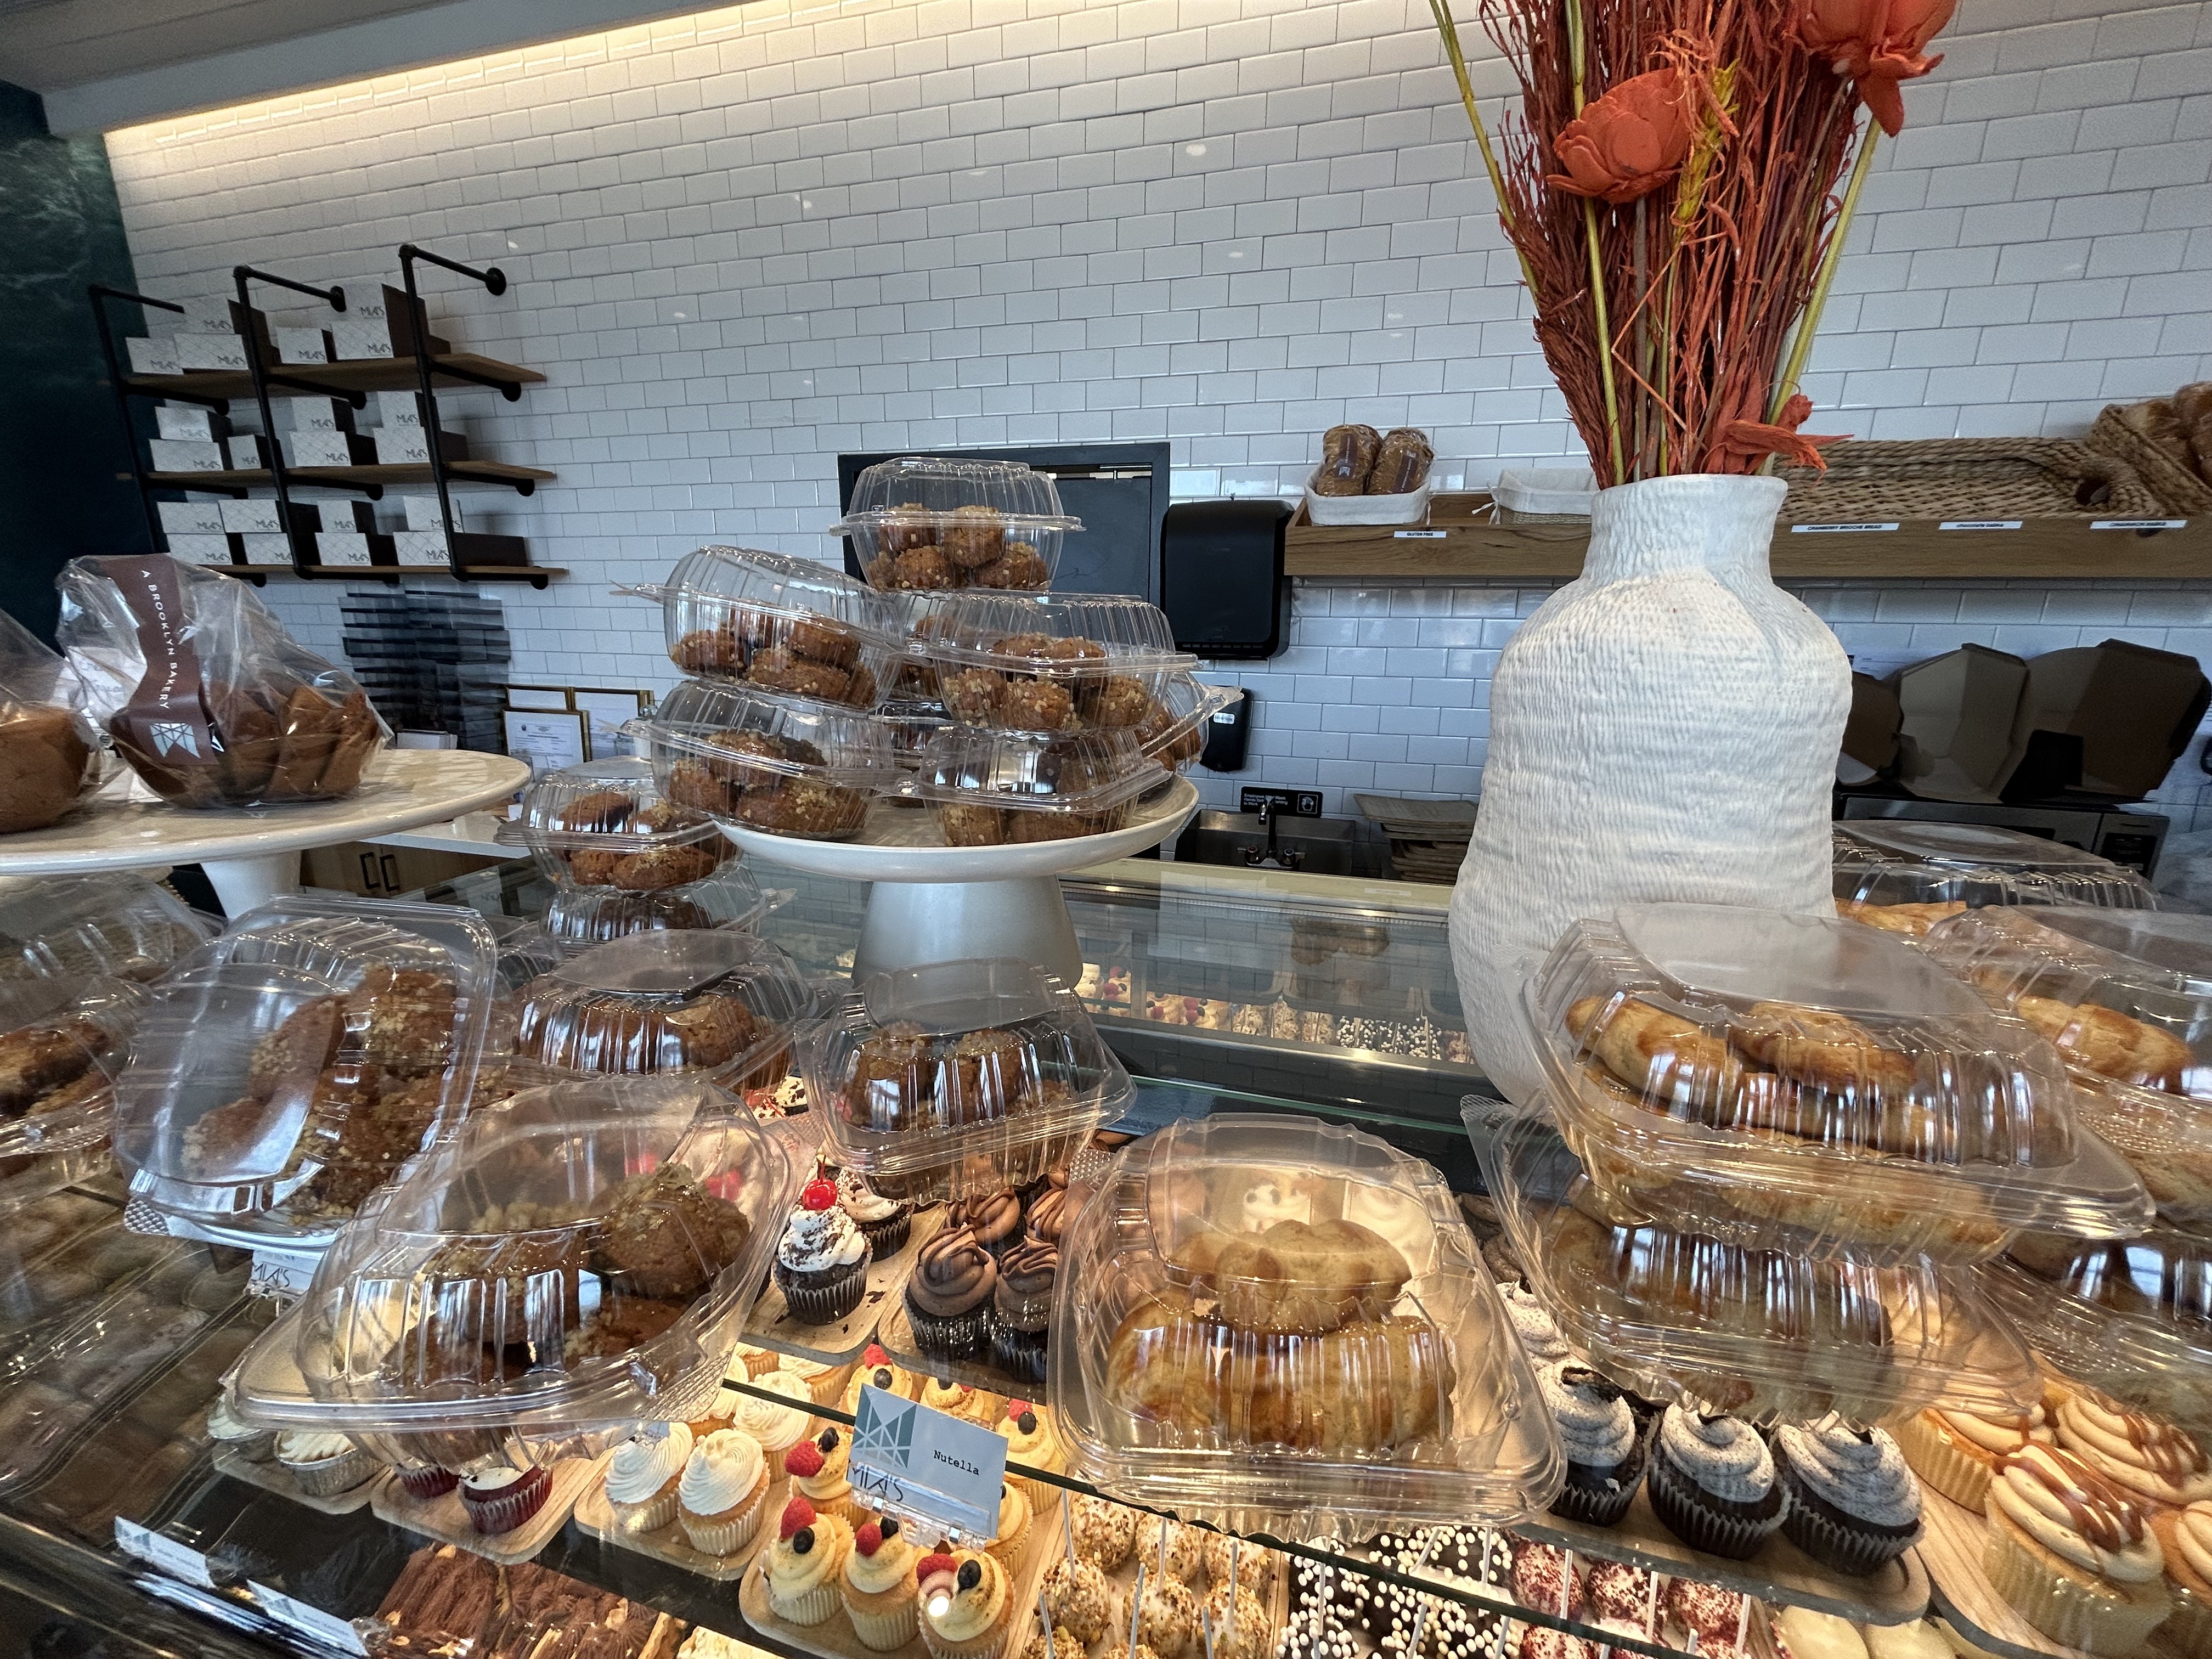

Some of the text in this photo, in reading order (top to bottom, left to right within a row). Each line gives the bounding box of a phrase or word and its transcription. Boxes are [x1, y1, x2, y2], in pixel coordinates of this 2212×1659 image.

[148, 584, 175, 656] BROOKLYN
[159, 662, 178, 709] BAKERY
[933, 1450, 979, 1476] Nutella
